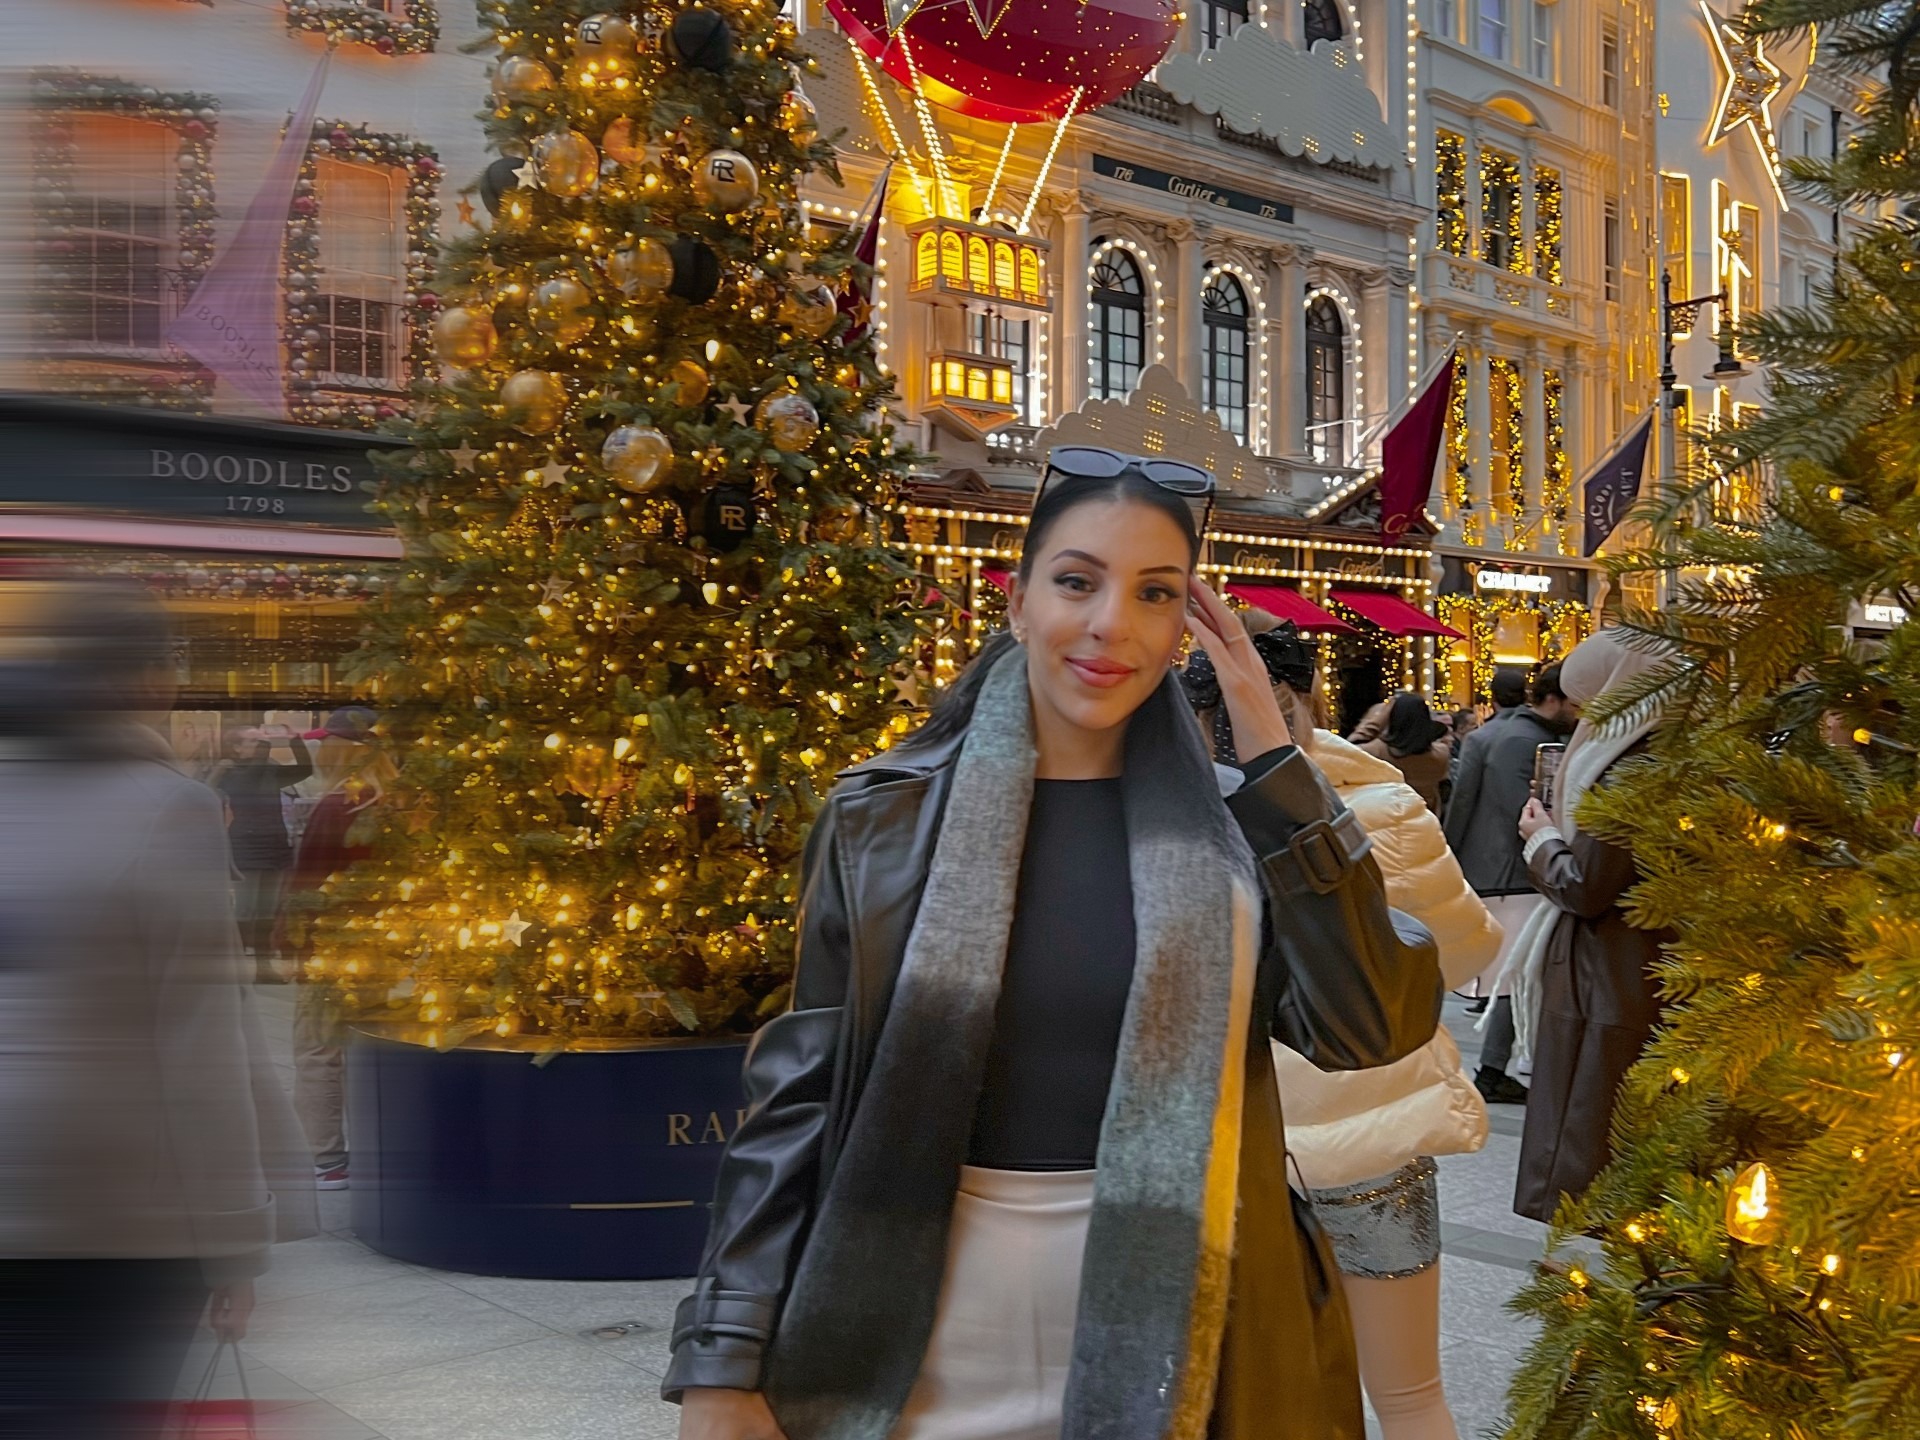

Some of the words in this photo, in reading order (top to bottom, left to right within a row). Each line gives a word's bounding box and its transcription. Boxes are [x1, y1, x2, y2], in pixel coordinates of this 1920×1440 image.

[1113, 166, 1135, 182] 176
[1168, 175, 1216, 202] Cartier
[1259, 204, 1277, 219] 175
[150, 449, 353, 493] BOODLES
[225, 495, 286, 514] 1798
[1233, 549, 1281, 570] Cartier
